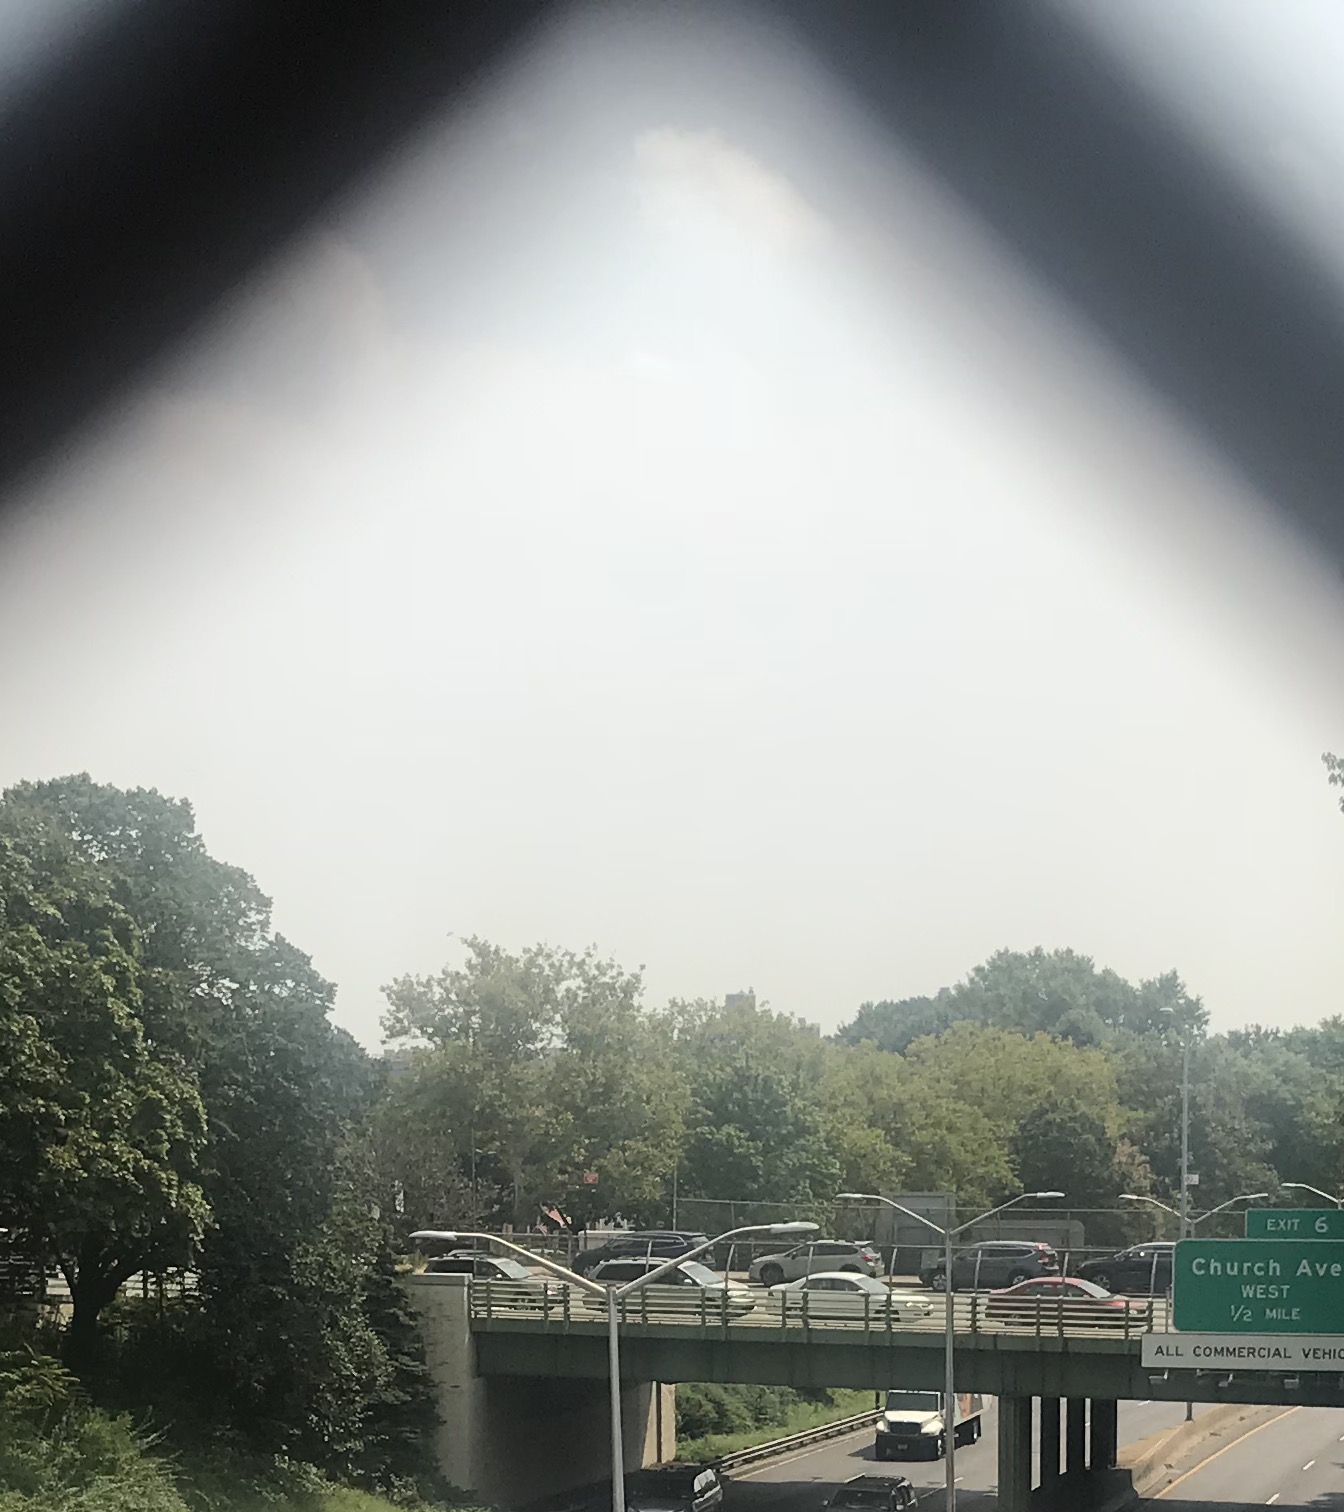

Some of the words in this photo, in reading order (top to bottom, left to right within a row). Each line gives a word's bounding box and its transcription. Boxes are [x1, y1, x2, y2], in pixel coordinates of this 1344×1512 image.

[1266, 1218, 1300, 1231] EXIT
[1314, 1216, 1328, 1233] 6
[1191, 1257, 1281, 1277] Church
[1295, 1258, 1342, 1277] Ave
[1241, 1284, 1290, 1299] WEST
[1265, 1308, 1301, 1320] MILE
[1154, 1345, 1184, 1357] ALL
[1192, 1345, 1292, 1359] COMMERCIAL
